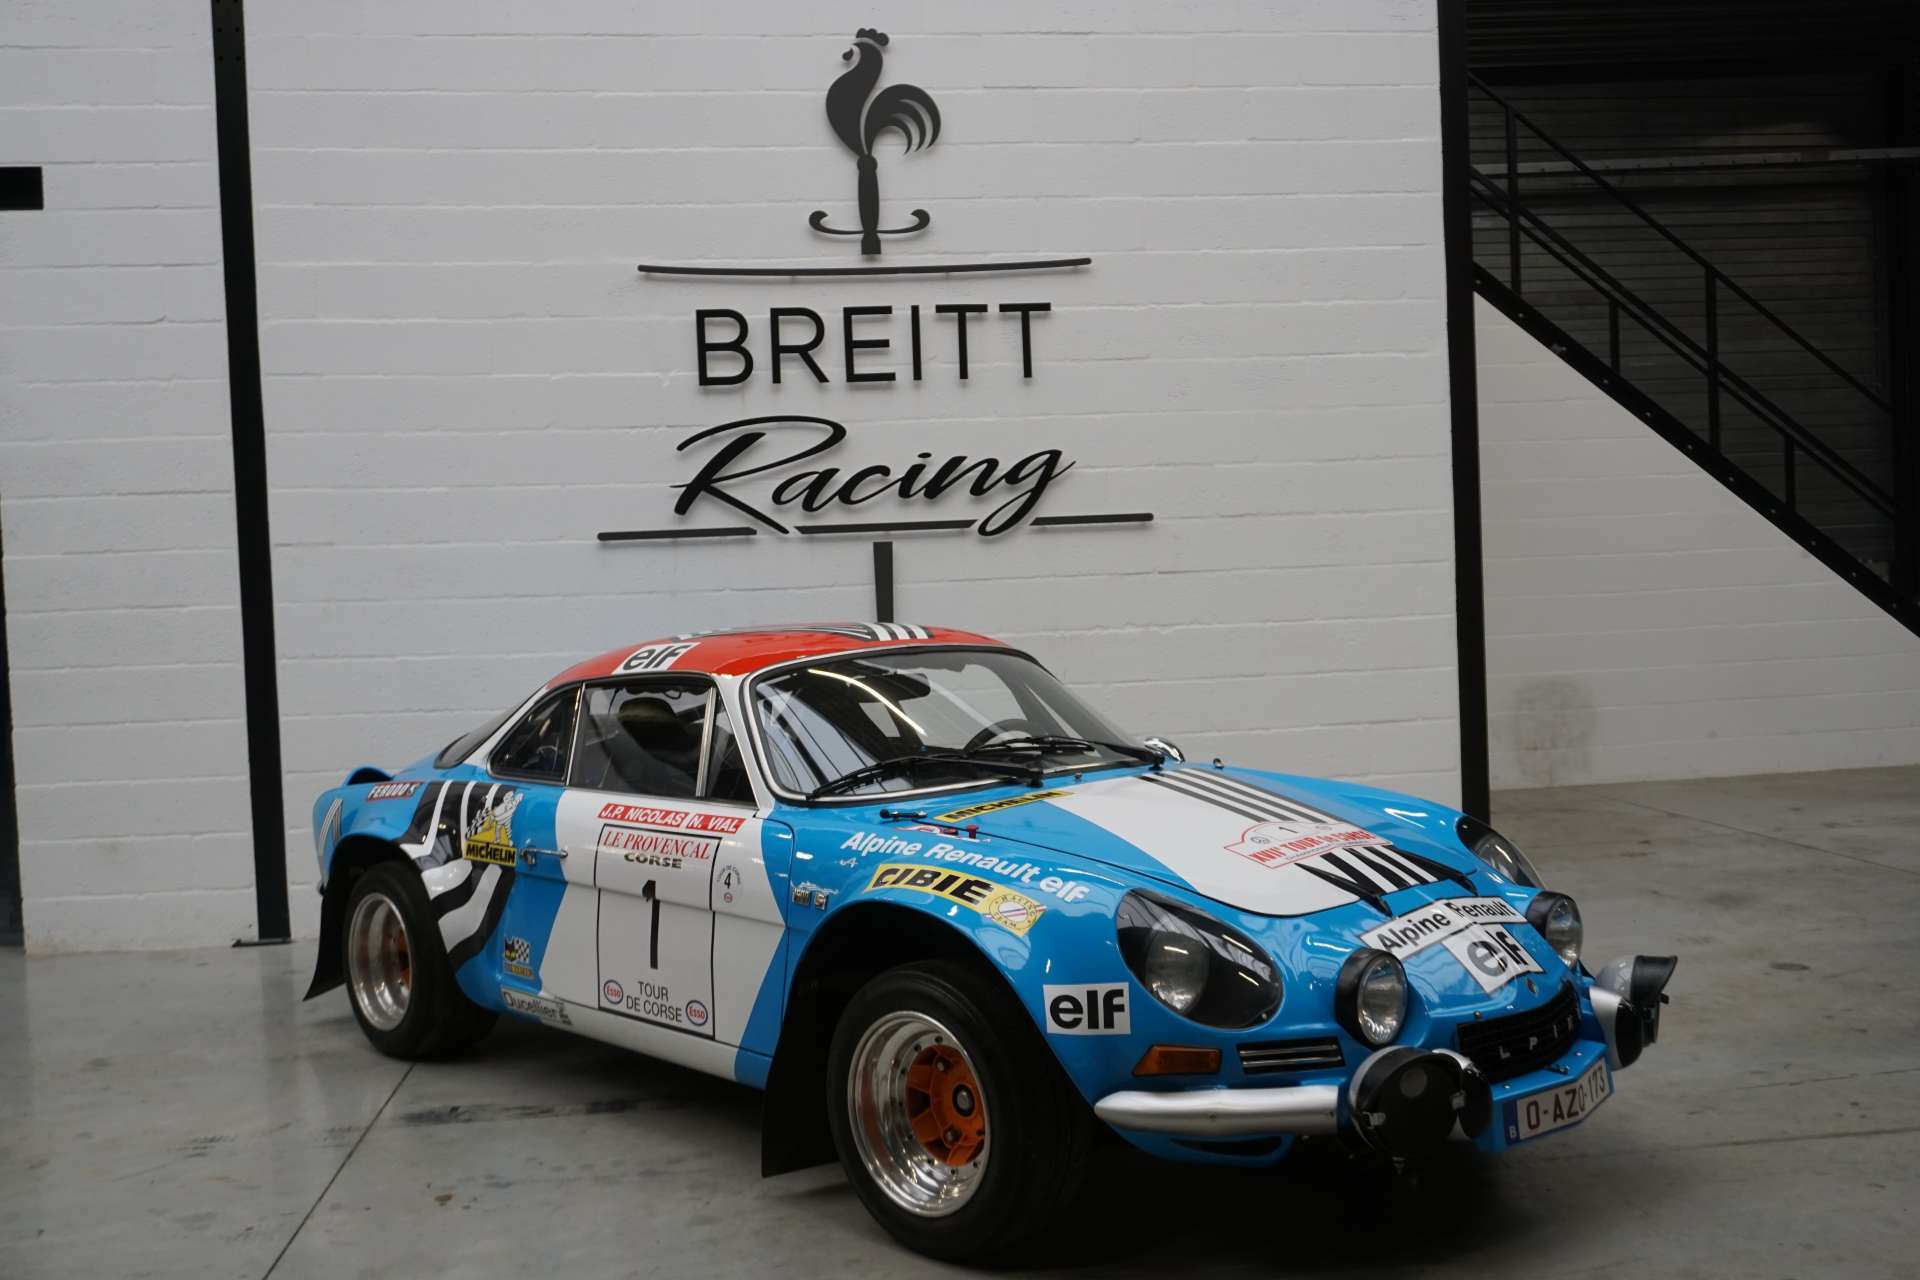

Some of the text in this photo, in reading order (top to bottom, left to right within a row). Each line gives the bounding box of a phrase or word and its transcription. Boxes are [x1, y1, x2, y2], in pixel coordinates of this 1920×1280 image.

[695, 302, 1051, 386] BREITT
[670, 415, 1076, 537] Racing
[623, 645, 692, 670] elf
[600, 806, 686, 826] J.P. NICOLAS
[944, 791, 1062, 819] MICHELIN
[688, 817, 741, 833] N. VIAL
[604, 831, 623, 847] LE
[1280, 837, 1322, 851] TOUR
[465, 843, 516, 865] MICHELIN
[624, 852, 683, 869] CORSE
[840, 831, 1091, 903] Alpine Renault elf
[724, 872, 732, 889] 4
[642, 880, 660, 970] 1
[1377, 912, 1451, 951] Alpine
[1467, 929, 1529, 977] elf
[638, 981, 669, 1001] TOUR
[626, 995, 682, 1023] DE CORSE
[1049, 988, 1125, 1030] elf
